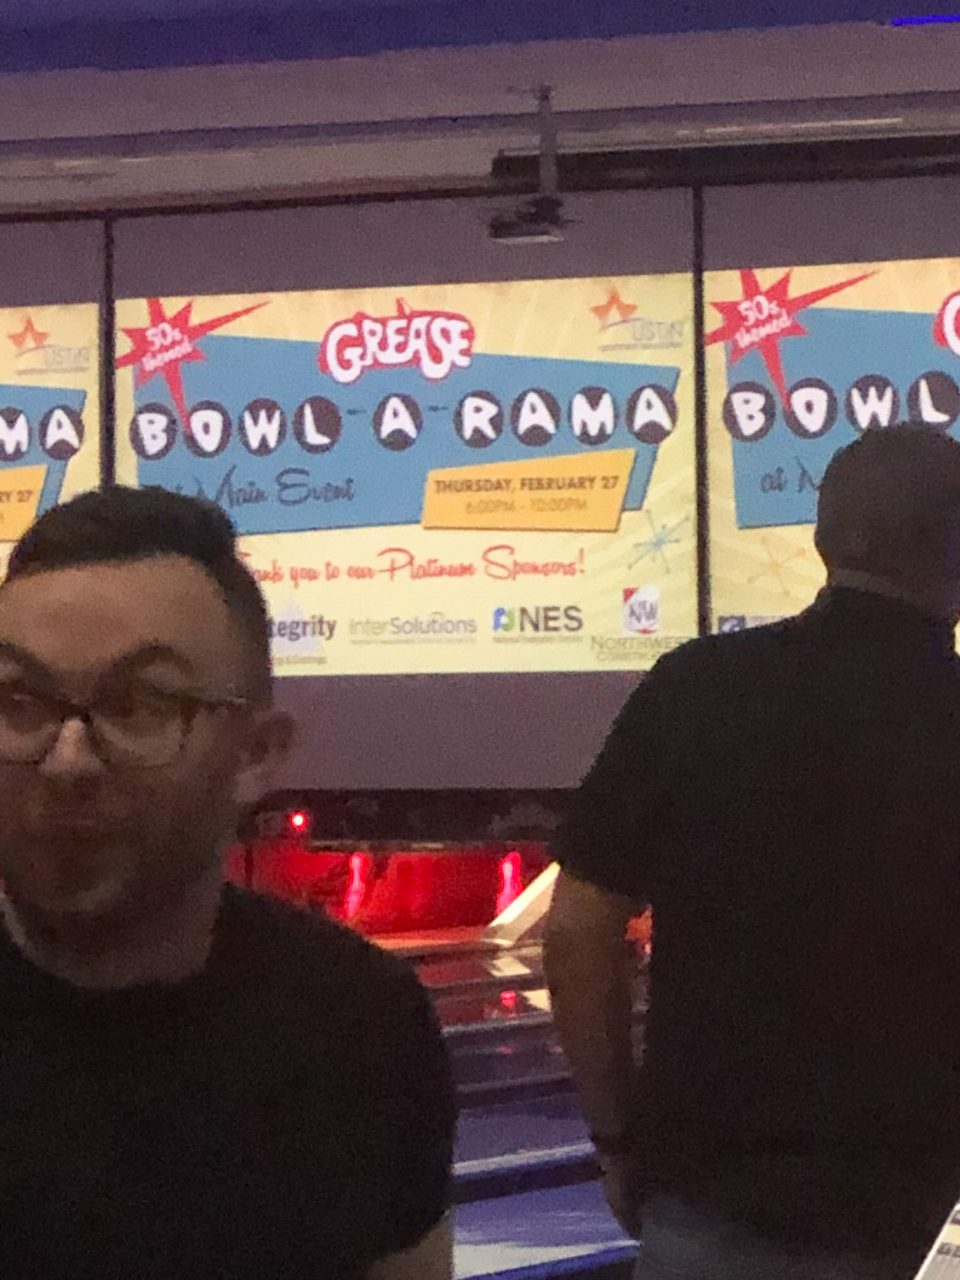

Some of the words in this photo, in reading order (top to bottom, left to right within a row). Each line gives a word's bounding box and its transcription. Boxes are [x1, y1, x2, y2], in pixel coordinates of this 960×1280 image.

[739, 295, 778, 325] 50s
[146, 323, 181, 350] 50s
[327, 317, 472, 383] GREASE
[275, 467, 355, 505] Event
[435, 477, 516, 494] THURSDAY,
[520, 475, 596, 491] FEBRUARY
[761, 467, 786, 492] at
[290, 566, 320, 588] you
[325, 562, 340, 579] to
[347, 567, 374, 579] our
[377, 547, 476, 581] Platinum
[482, 544, 585, 581] Sponsors!
[268, 615, 337, 641] tegrity
[350, 612, 477, 635] InterSolutions
[520, 606, 584, 632] NES
